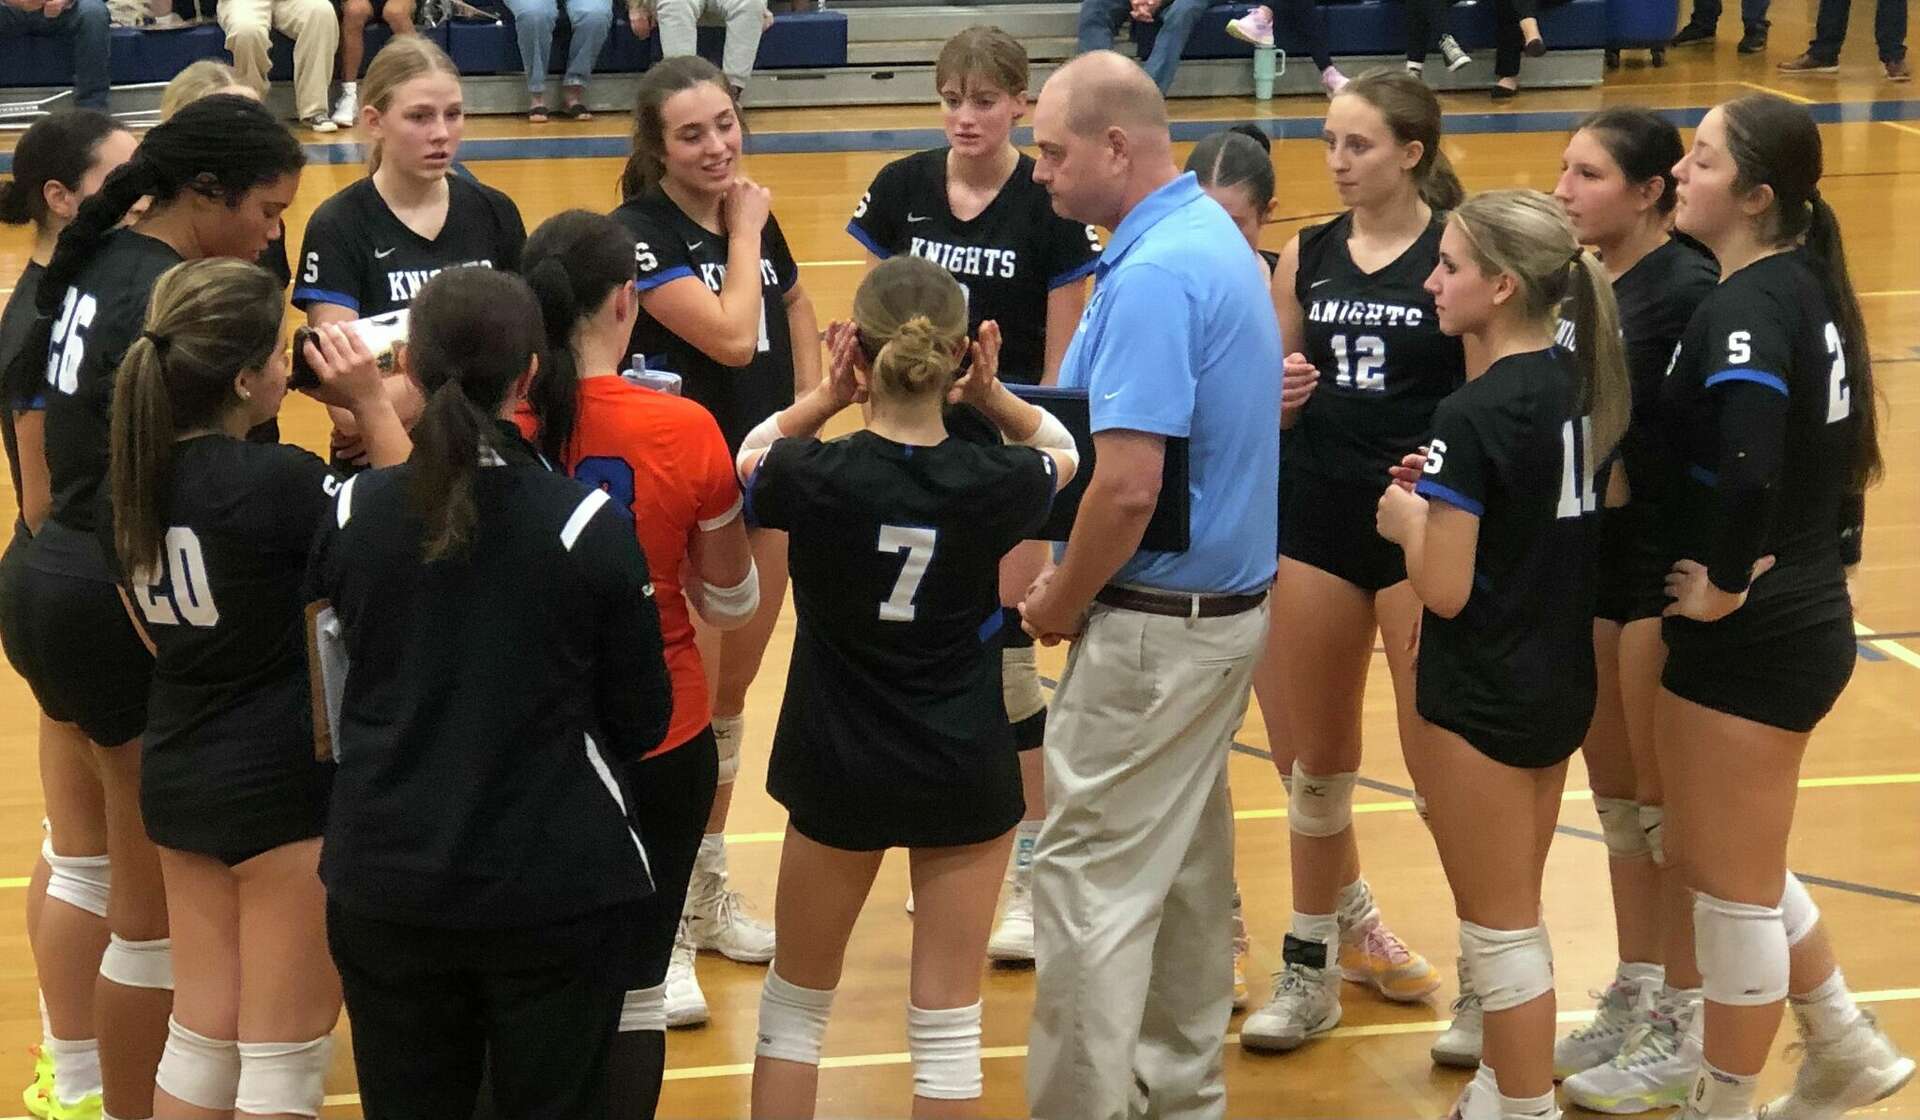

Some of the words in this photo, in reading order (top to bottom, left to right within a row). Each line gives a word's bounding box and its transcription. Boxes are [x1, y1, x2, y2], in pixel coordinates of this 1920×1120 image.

[634, 242, 659, 272] S
[1085, 224, 1103, 252] S
[304, 252, 320, 284] S
[910, 237, 1016, 278] KNIGHTS
[46, 285, 97, 395] 26
[1728, 331, 1751, 364] S
[1330, 334, 1385, 391] 12
[1824, 321, 1851, 425] 2
[1422, 439, 1448, 475] S
[878, 524, 937, 622] 7
